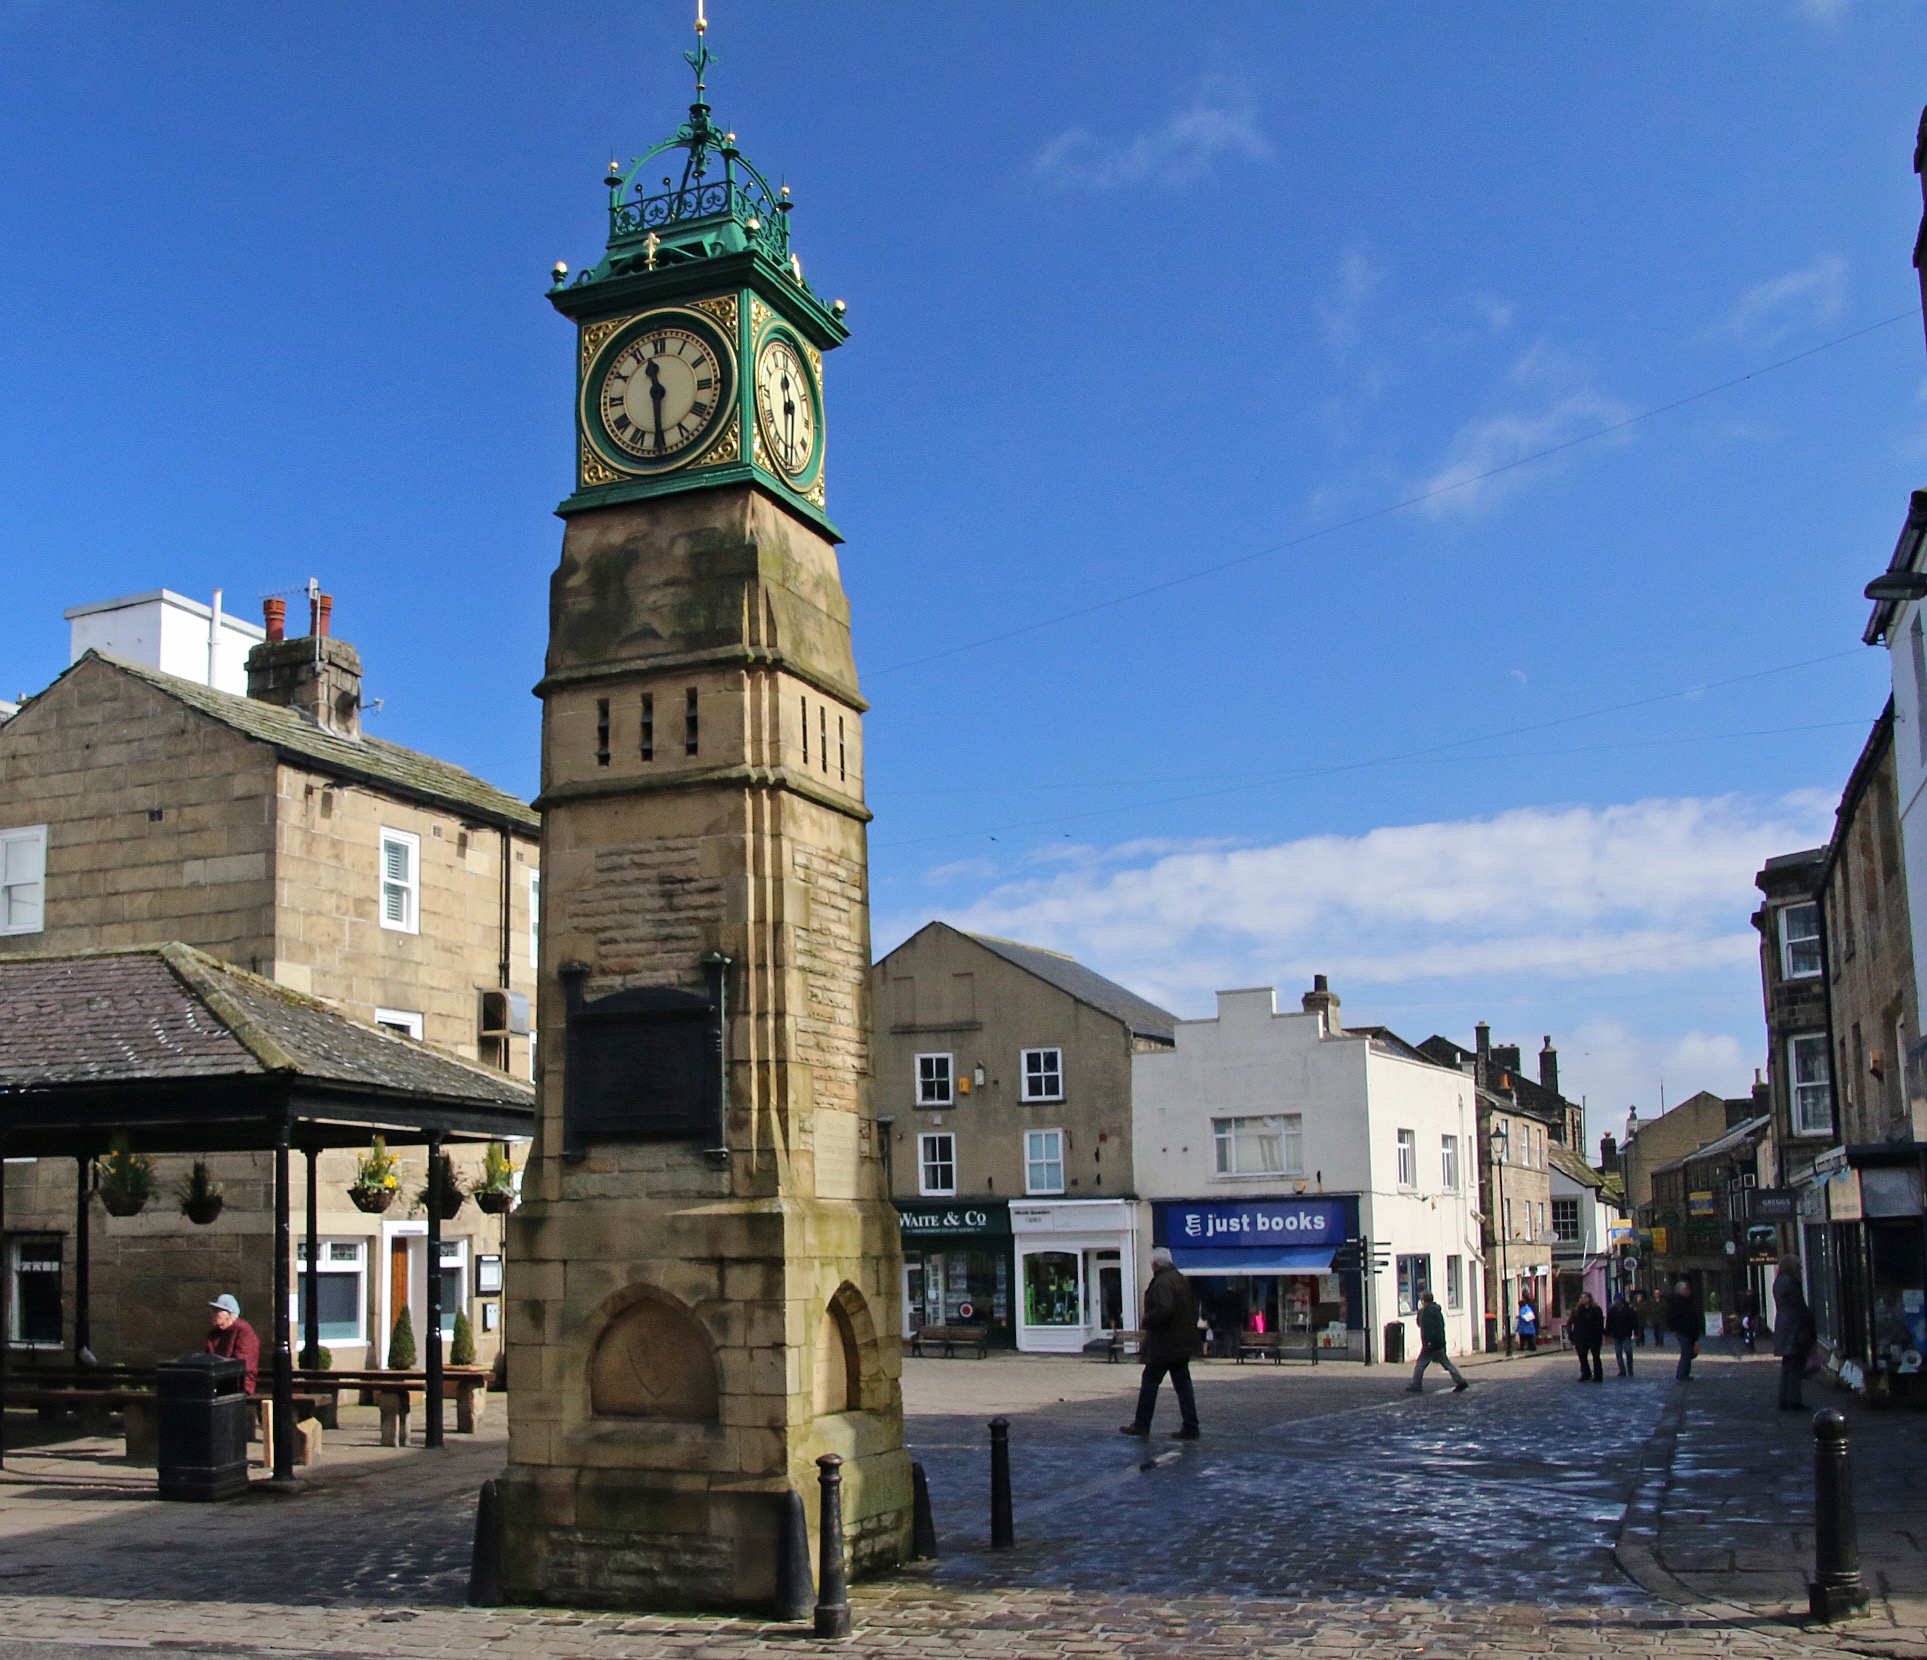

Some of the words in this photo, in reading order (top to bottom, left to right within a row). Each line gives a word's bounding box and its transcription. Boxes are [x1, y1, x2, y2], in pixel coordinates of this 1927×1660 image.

[943, 1211, 961, 1226] &
[1206, 1213, 1251, 1237] just
[1256, 1211, 1326, 1231] books
